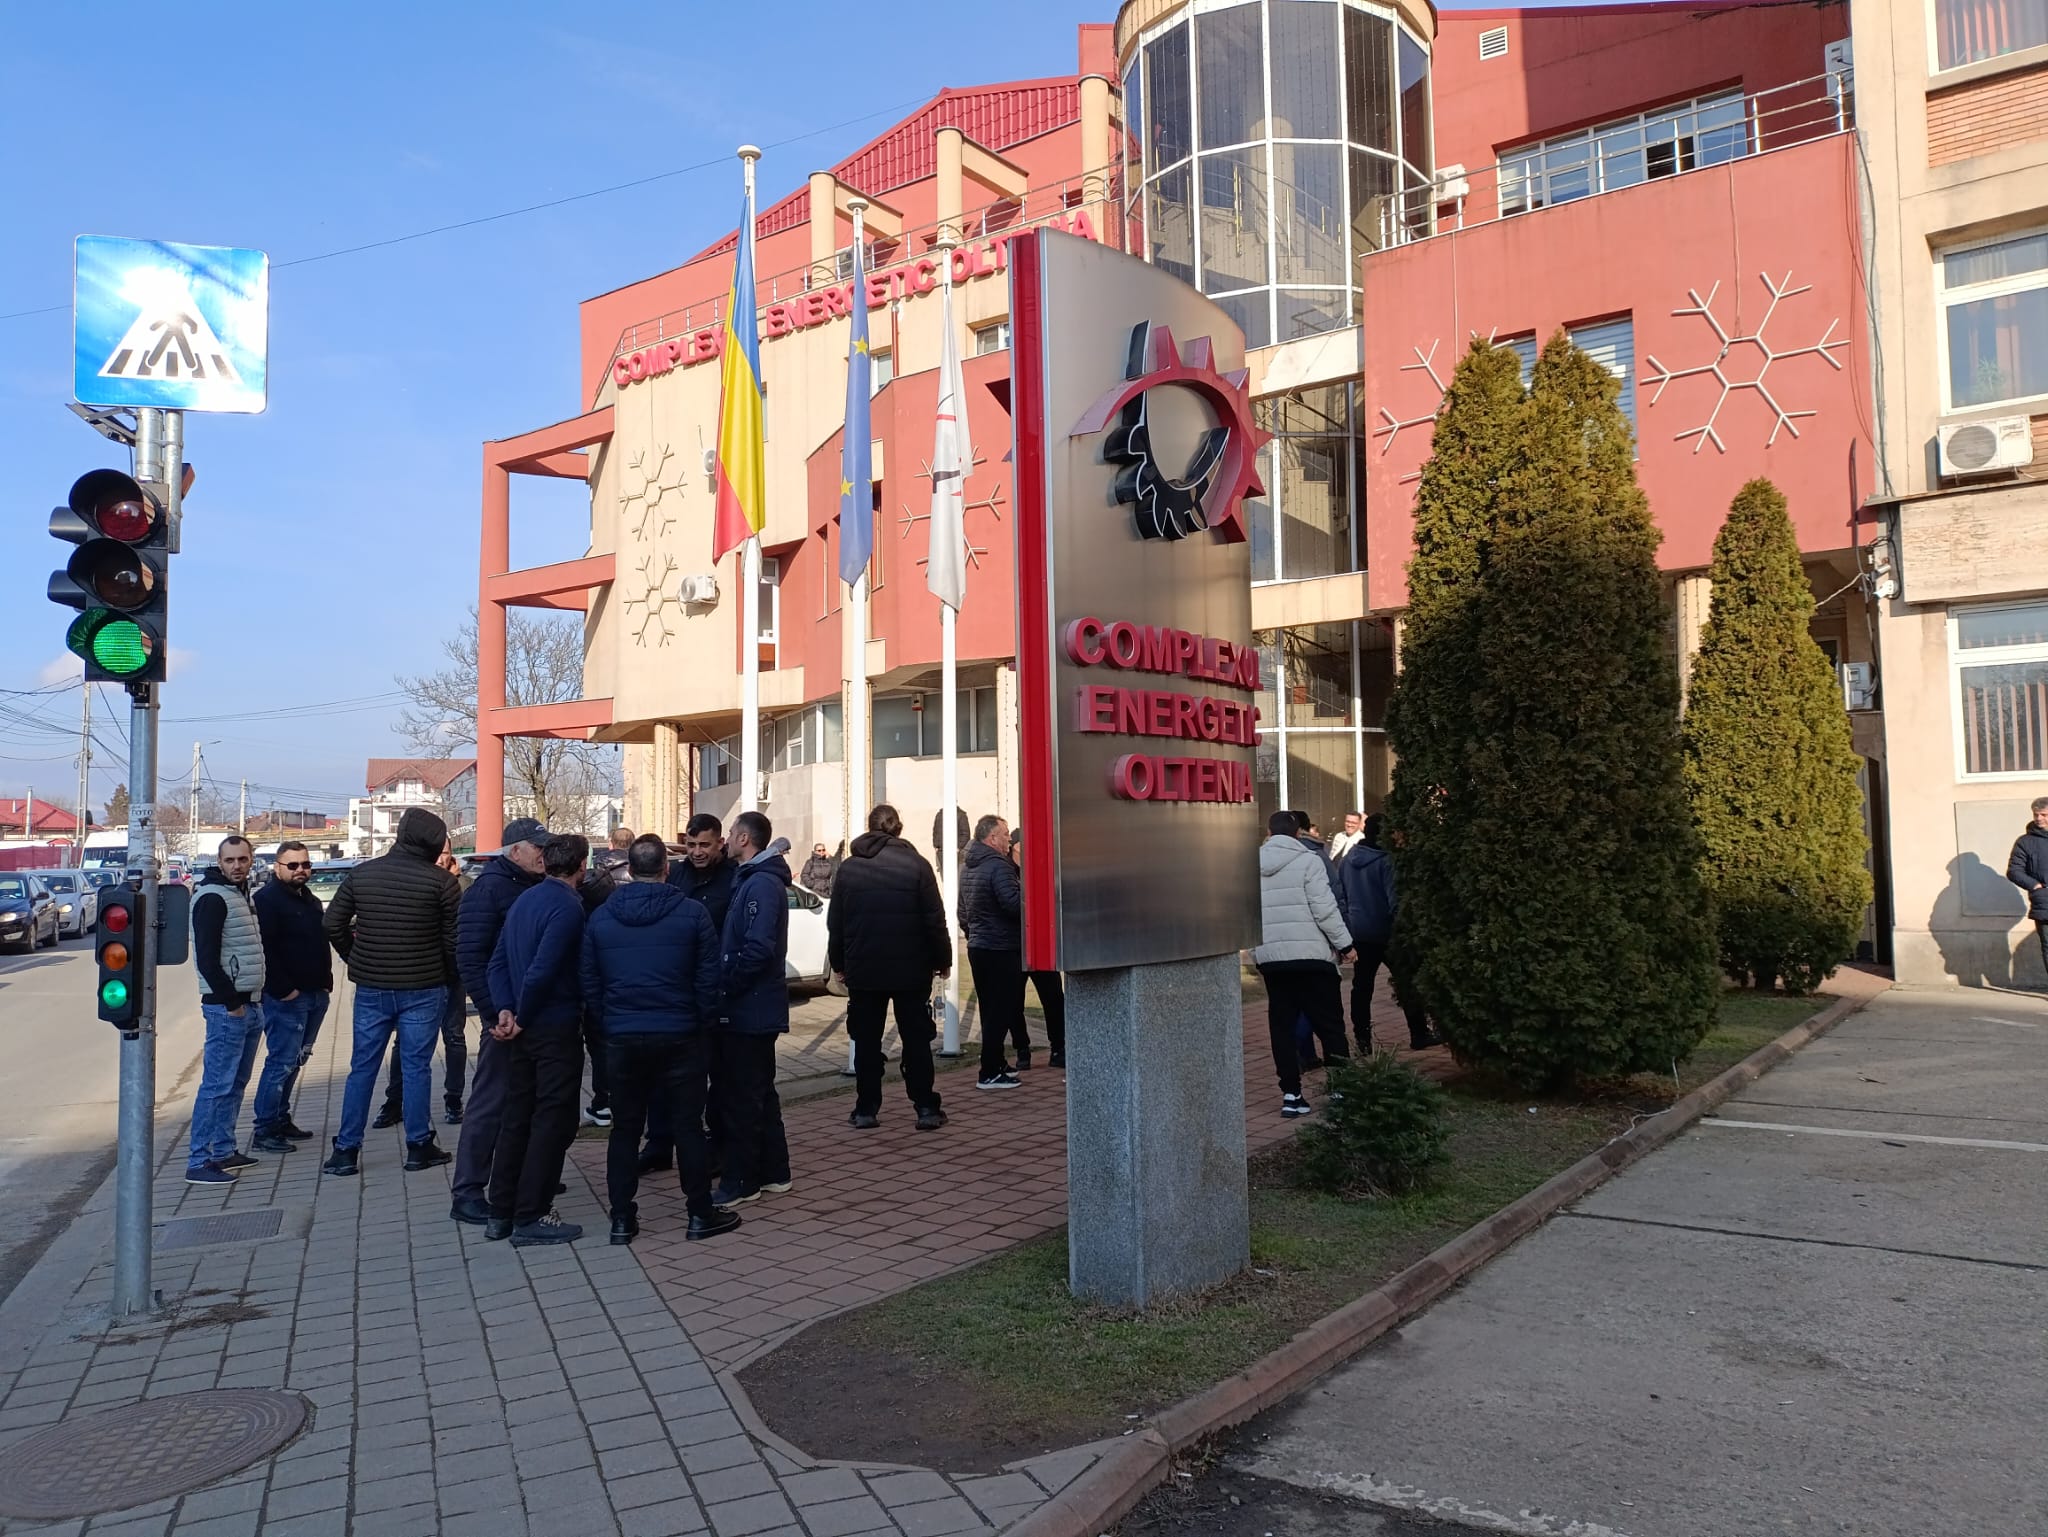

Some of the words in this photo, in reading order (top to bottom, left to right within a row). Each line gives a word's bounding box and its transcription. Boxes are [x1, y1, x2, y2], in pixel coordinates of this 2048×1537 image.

[1066, 616, 1264, 691] COMPLEXUL
[1079, 685, 1263, 747] ENERGETIC
[1113, 753, 1255, 803] OLTENIA
